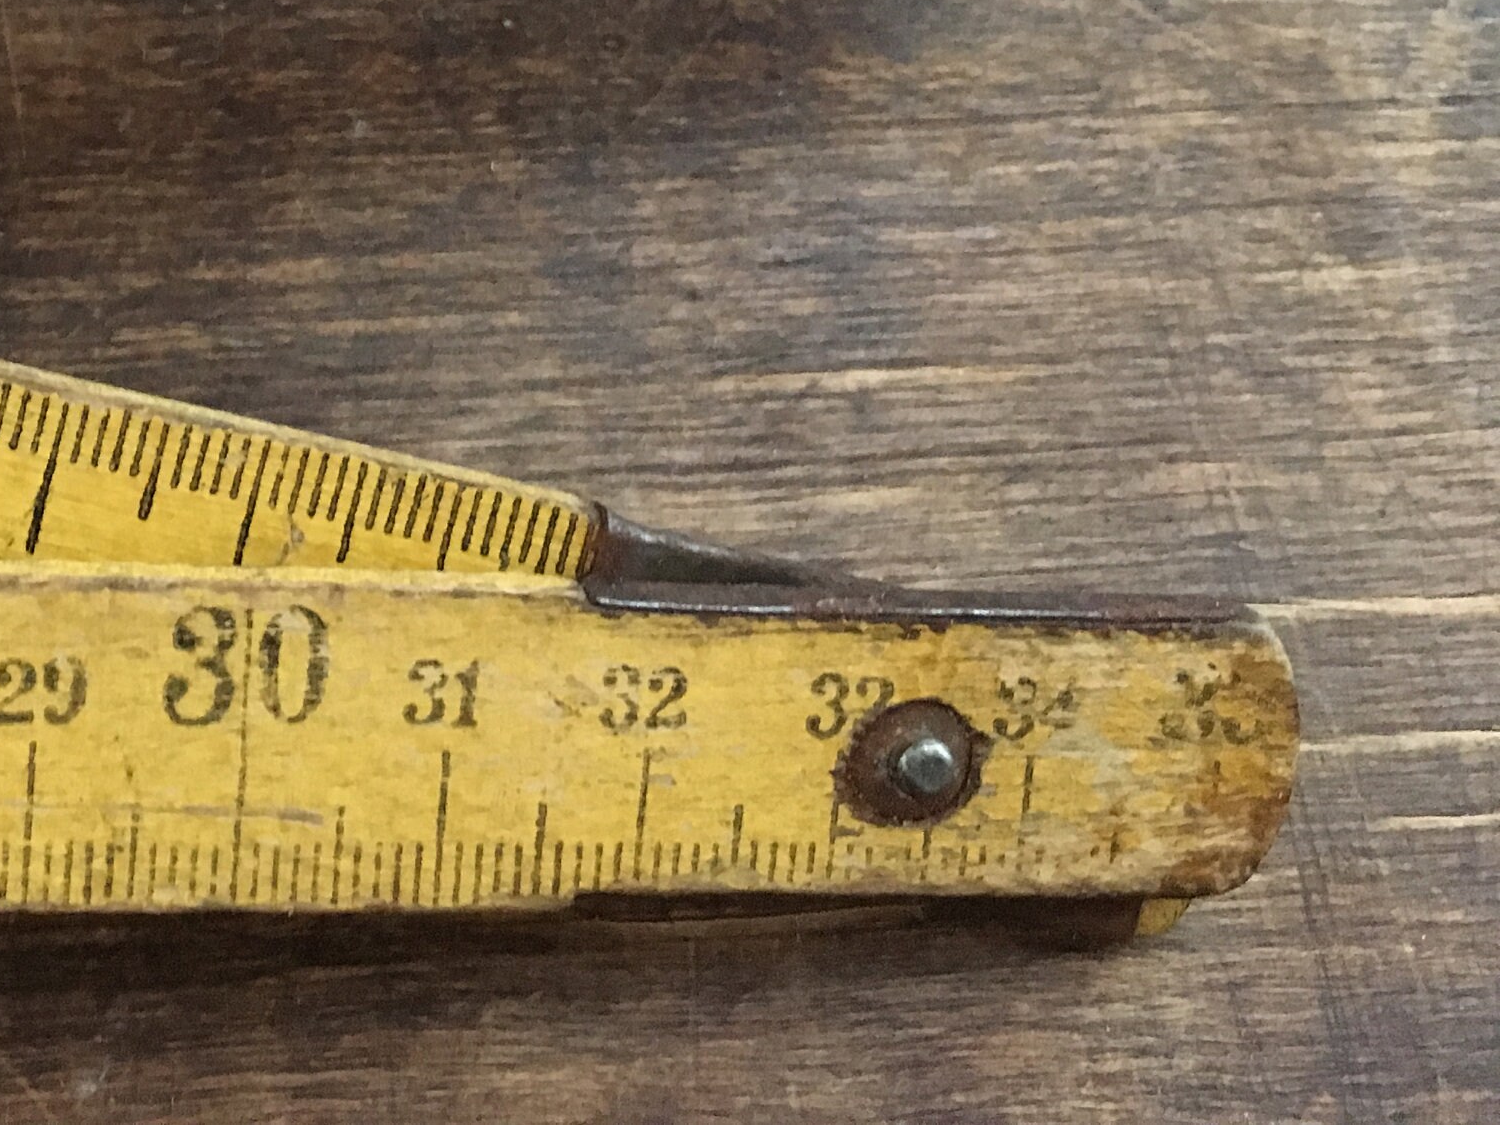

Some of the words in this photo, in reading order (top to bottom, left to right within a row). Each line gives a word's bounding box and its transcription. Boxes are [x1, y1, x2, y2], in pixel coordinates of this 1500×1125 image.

[162, 605, 330, 727] 30
[403, 658, 480, 728] 31
[598, 664, 688, 735] 32
